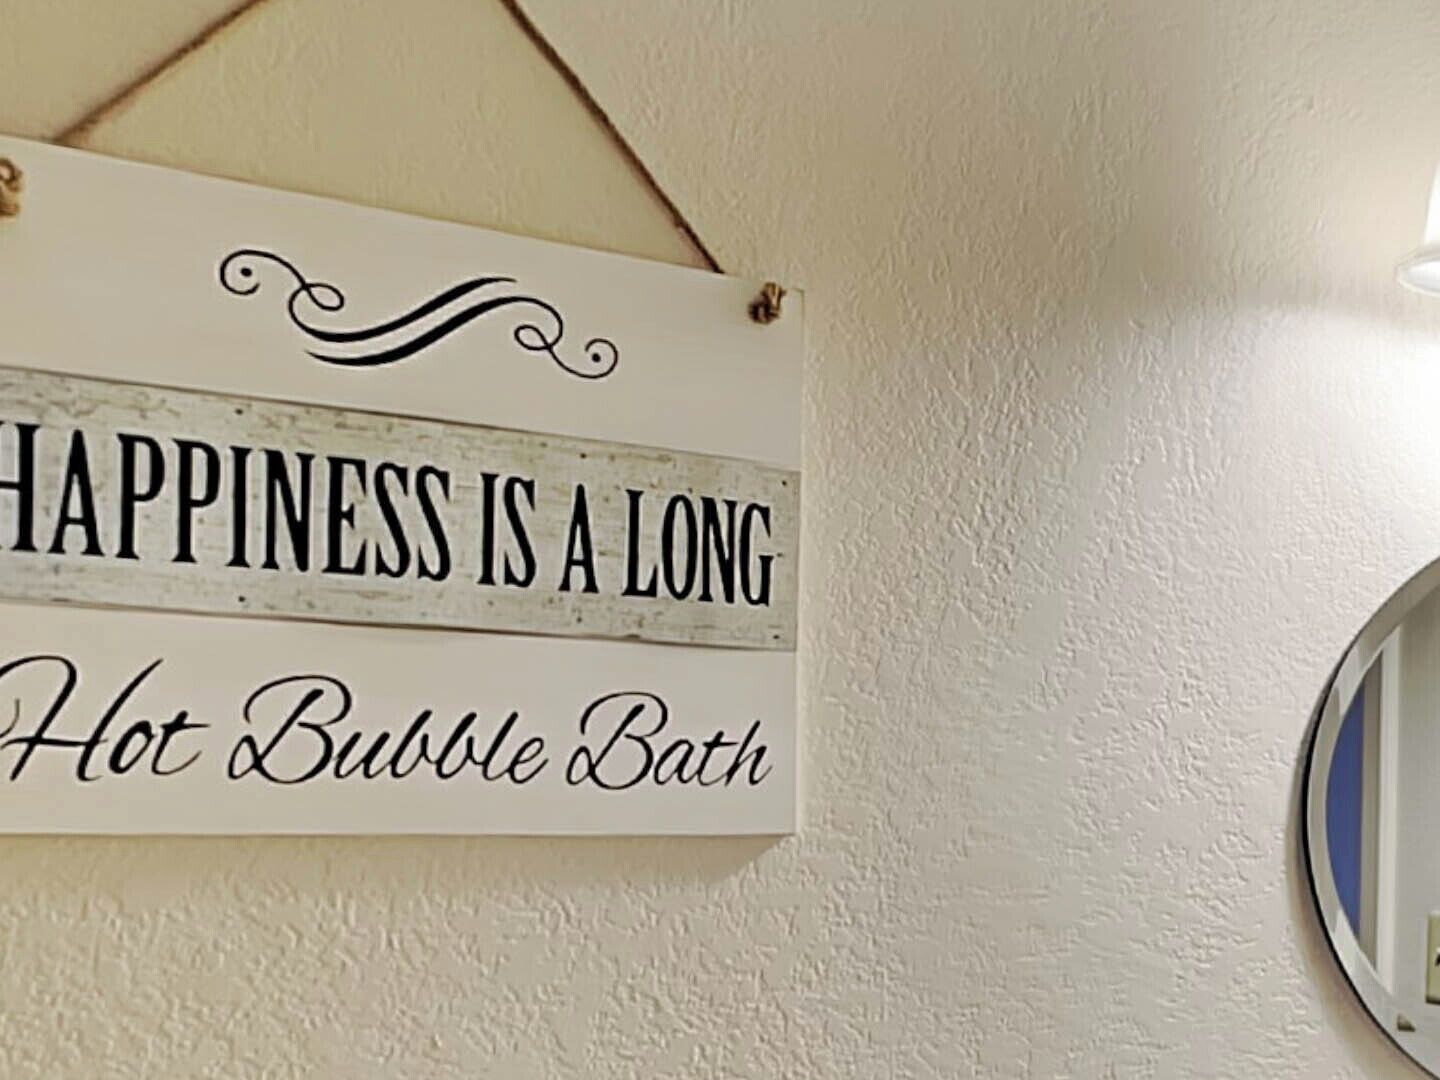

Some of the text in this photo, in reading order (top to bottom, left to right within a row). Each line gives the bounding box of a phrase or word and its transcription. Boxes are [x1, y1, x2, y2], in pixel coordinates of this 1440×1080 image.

[0, 420, 775, 607] HAPPINESS IS A LONG
[0, 655, 772, 790] Hot Bubble Bath
